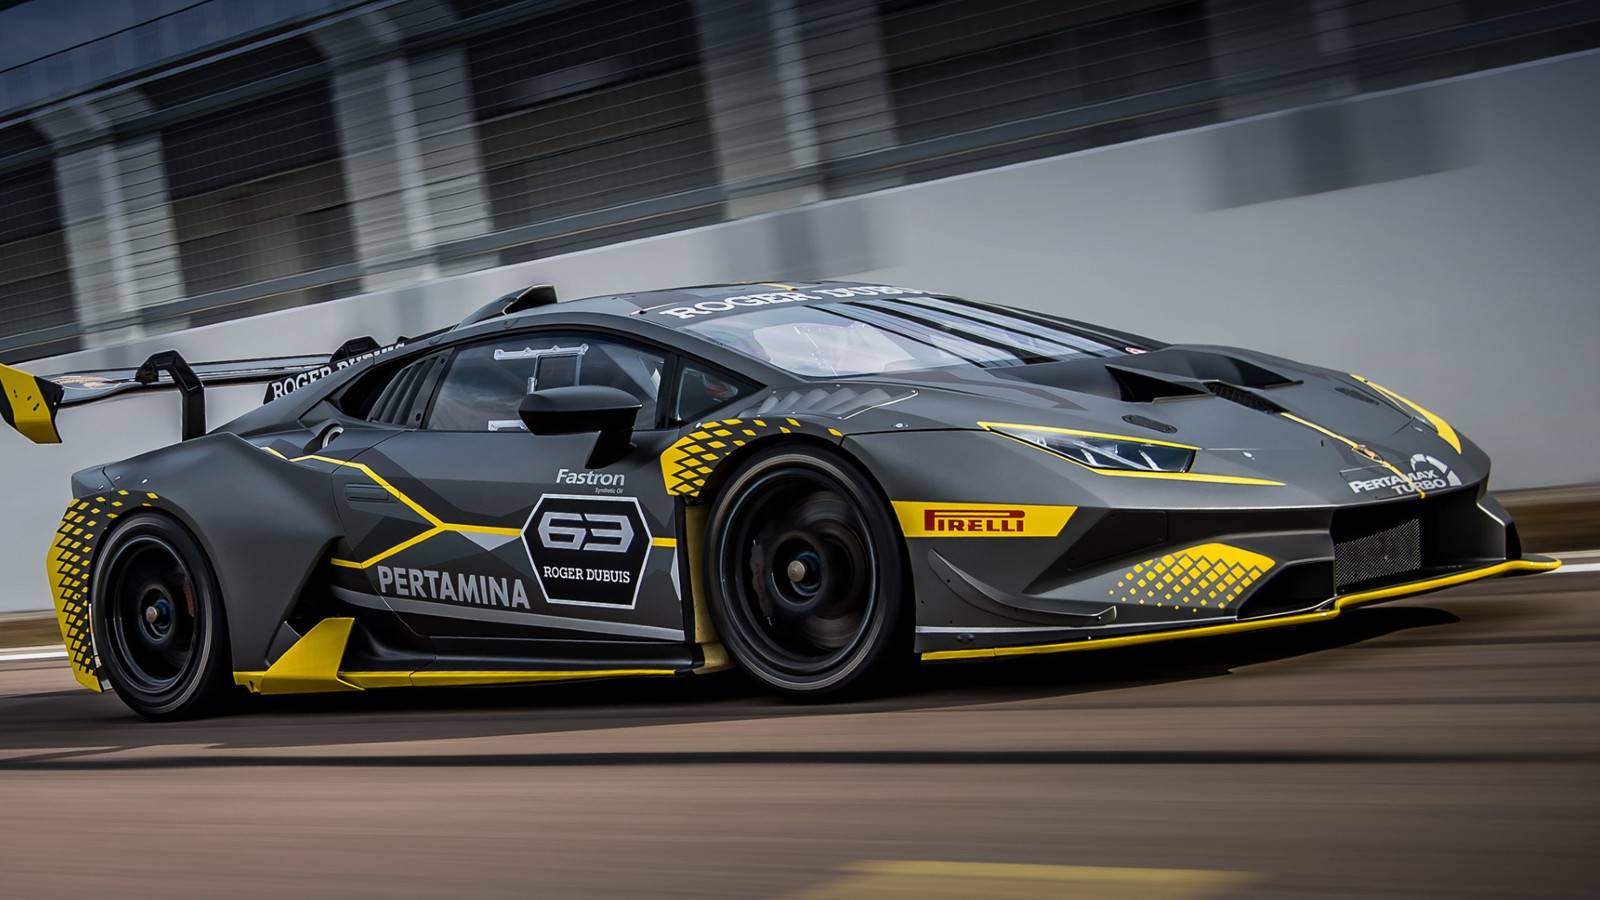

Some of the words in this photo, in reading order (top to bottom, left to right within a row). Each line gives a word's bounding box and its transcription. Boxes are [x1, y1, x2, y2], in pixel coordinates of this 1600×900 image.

[658, 291, 823, 319] ROGER
[555, 468, 625, 486] Fastron
[1348, 469, 1439, 494] PERTAMAX
[1391, 478, 1447, 495] TURBO
[537, 511, 635, 553] 63
[924, 509, 1025, 532] PIRELLI
[543, 566, 584, 580] ROGER
[586, 569, 631, 584] DUBUIS
[377, 565, 531, 610] PERTAMINA
